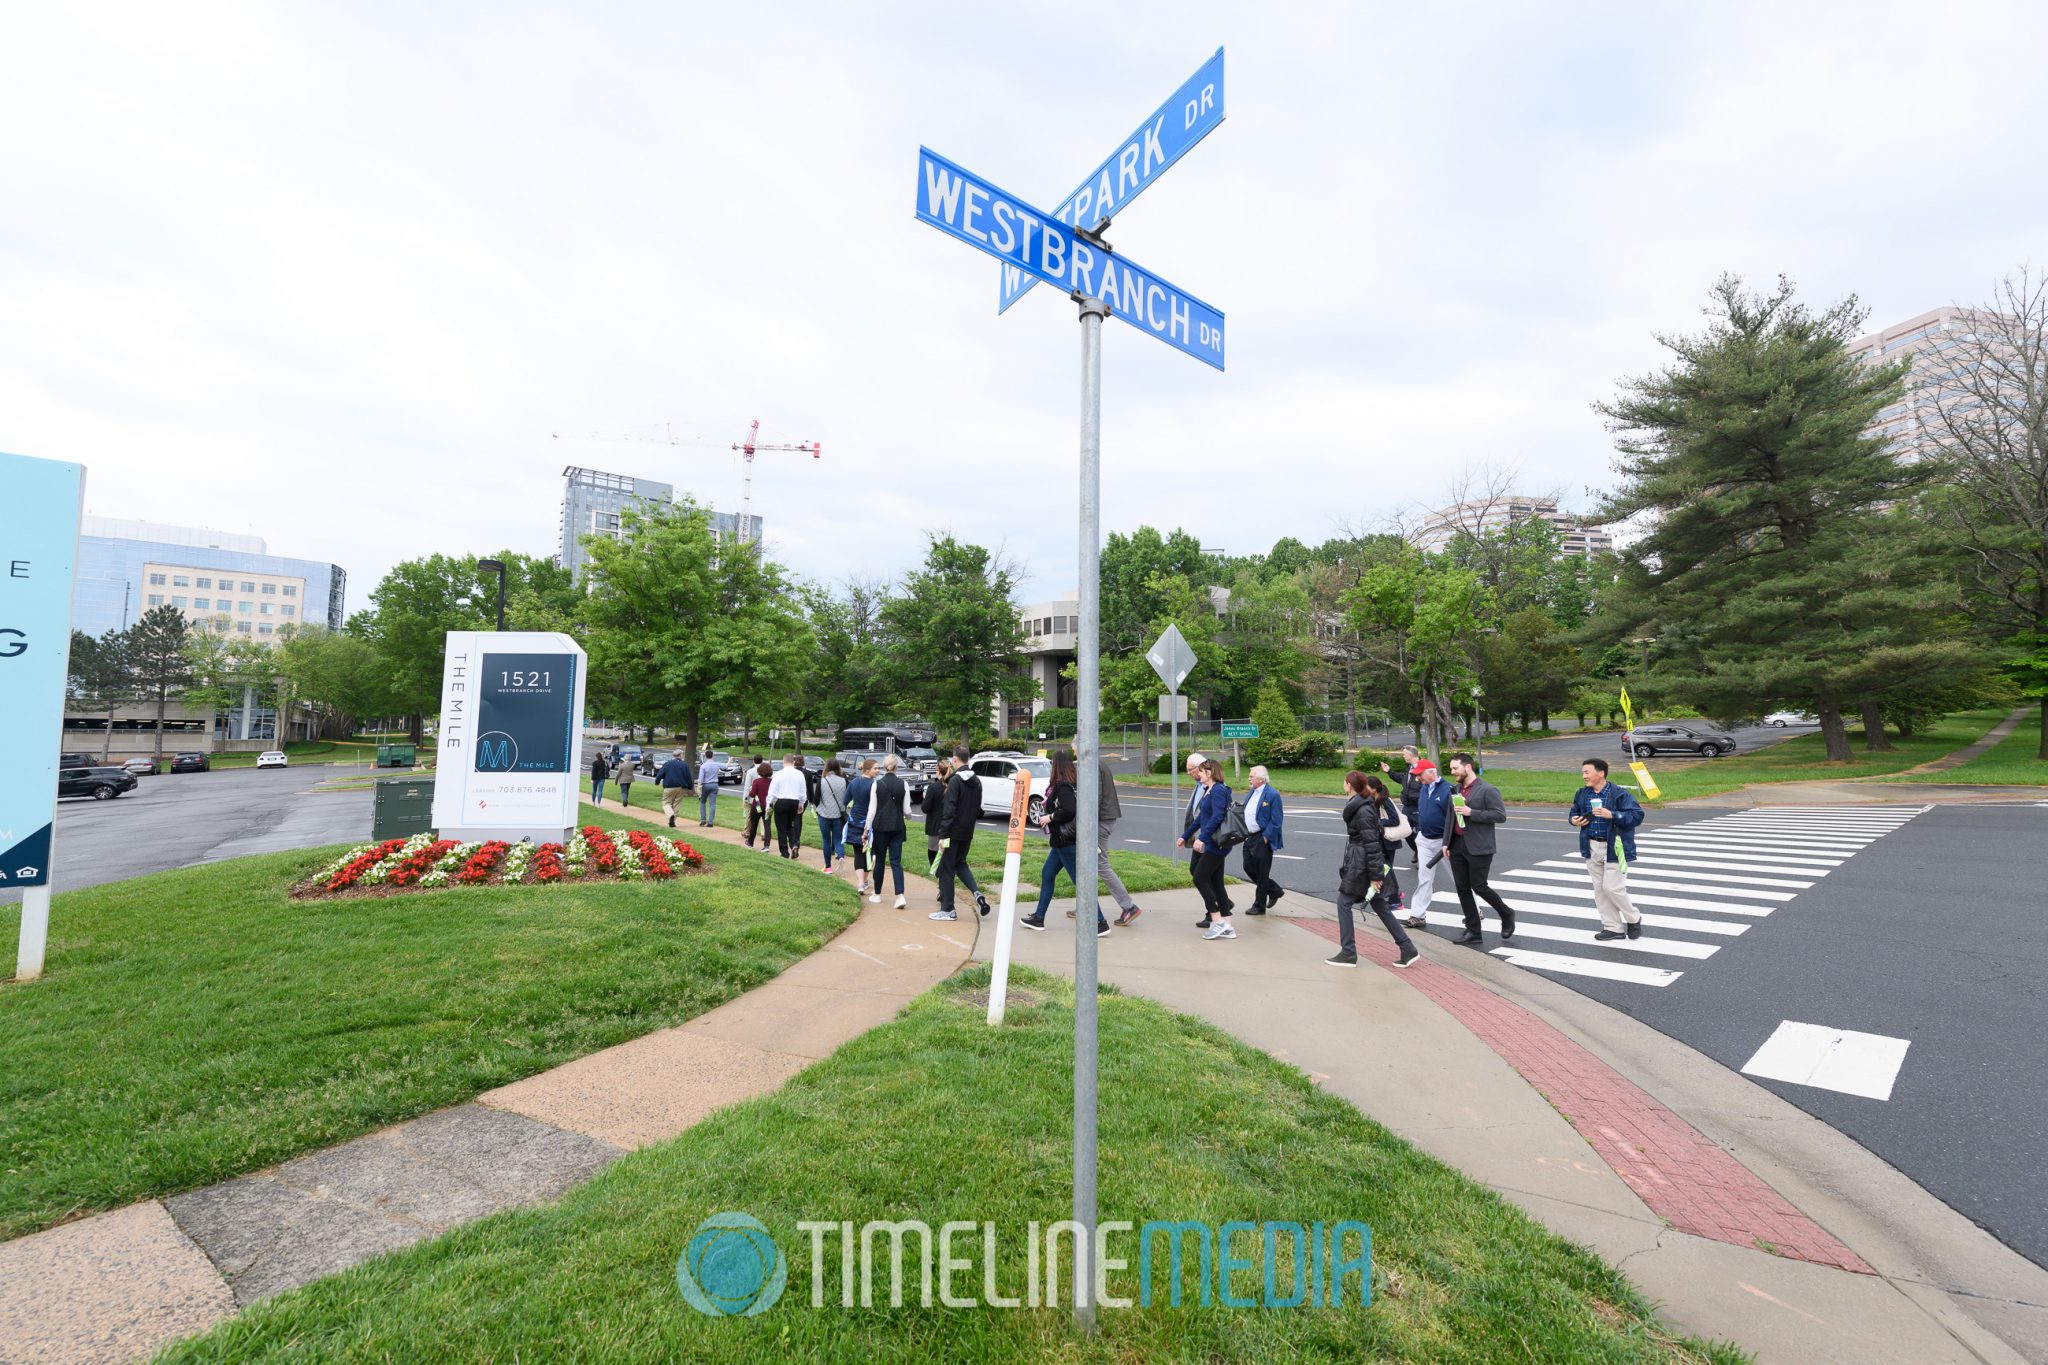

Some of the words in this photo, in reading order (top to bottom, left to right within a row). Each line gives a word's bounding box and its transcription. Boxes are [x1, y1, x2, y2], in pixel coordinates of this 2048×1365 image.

[1184, 82, 1215, 131] DR
[925, 159, 1189, 346] WESTBRANCH
[1200, 321, 1221, 353] DR
[452, 652, 467, 692] THE
[501, 671, 550, 687] 1521
[447, 700, 464, 748] MILE
